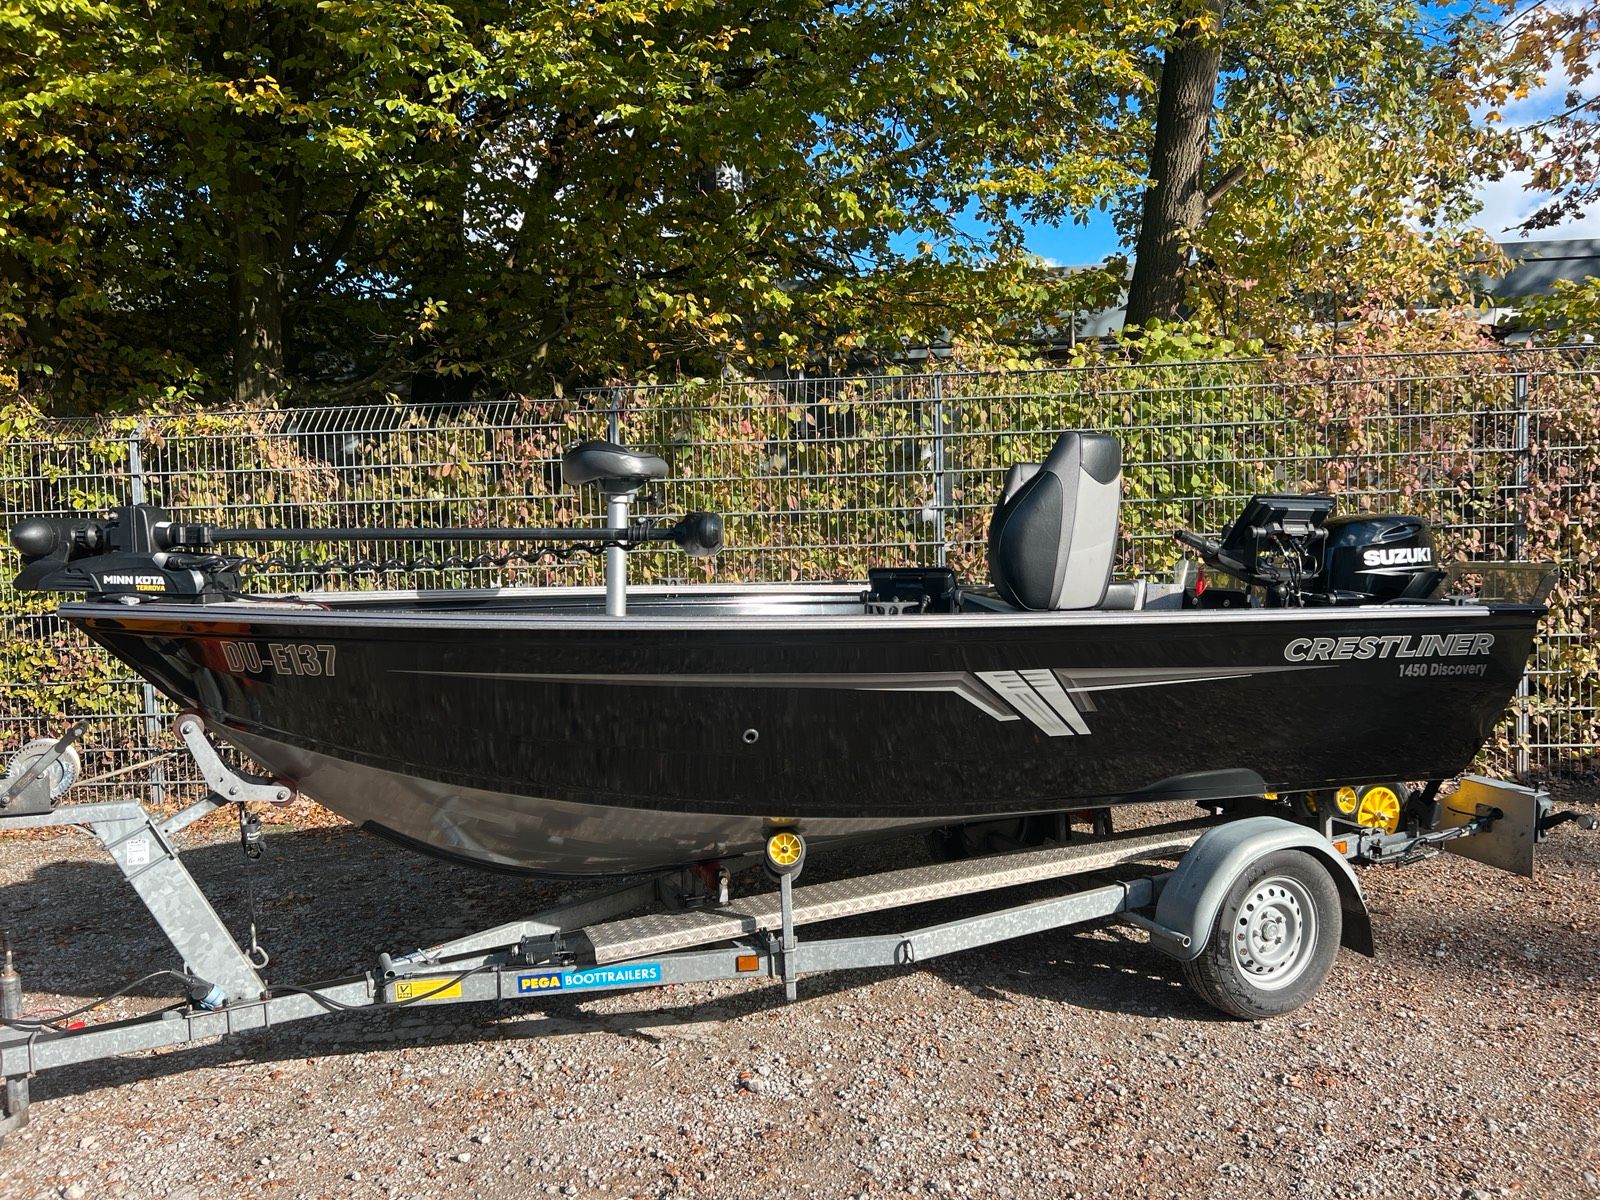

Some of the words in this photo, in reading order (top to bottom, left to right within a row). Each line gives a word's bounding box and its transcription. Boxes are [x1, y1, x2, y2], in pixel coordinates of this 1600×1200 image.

[1363, 547, 1431, 566] SUZUKI
[103, 575, 133, 585] MINN
[135, 575, 165, 585] KOTA
[1284, 633, 1495, 662] CRESTLINER
[220, 641, 336, 677] DU-E137
[1400, 663, 1427, 677] 1450
[1429, 663, 1487, 677] Discovery
[521, 977, 561, 990] PEGA
[565, 967, 657, 986] BOOTTRAILERS
